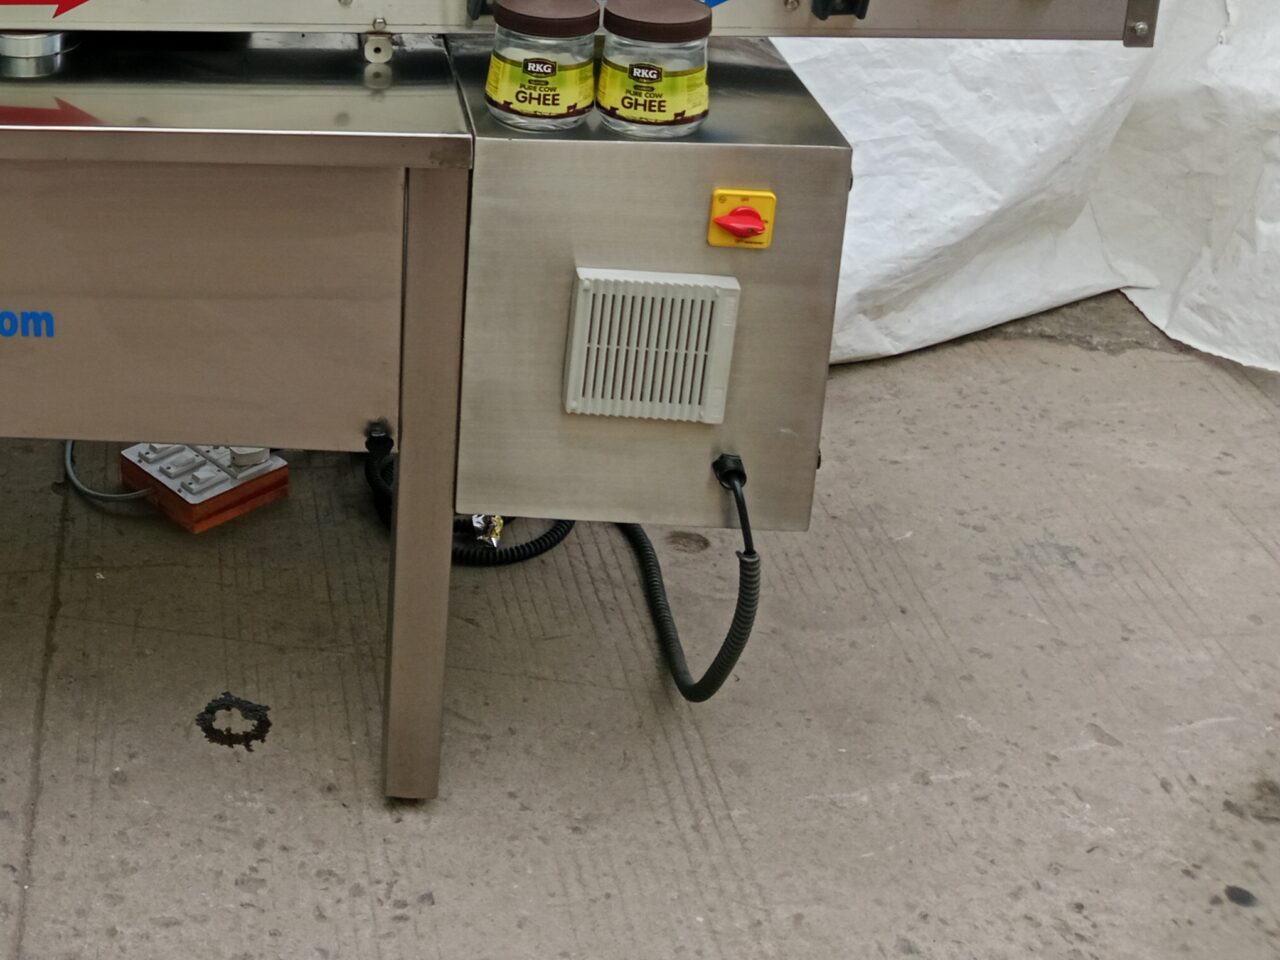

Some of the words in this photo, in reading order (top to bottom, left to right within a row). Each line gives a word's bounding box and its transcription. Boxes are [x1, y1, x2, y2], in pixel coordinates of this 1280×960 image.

[527, 62, 552, 73] RKG
[632, 67, 658, 79] RKG
[515, 90, 560, 106] GHEE
[621, 95, 667, 113] GHEE
